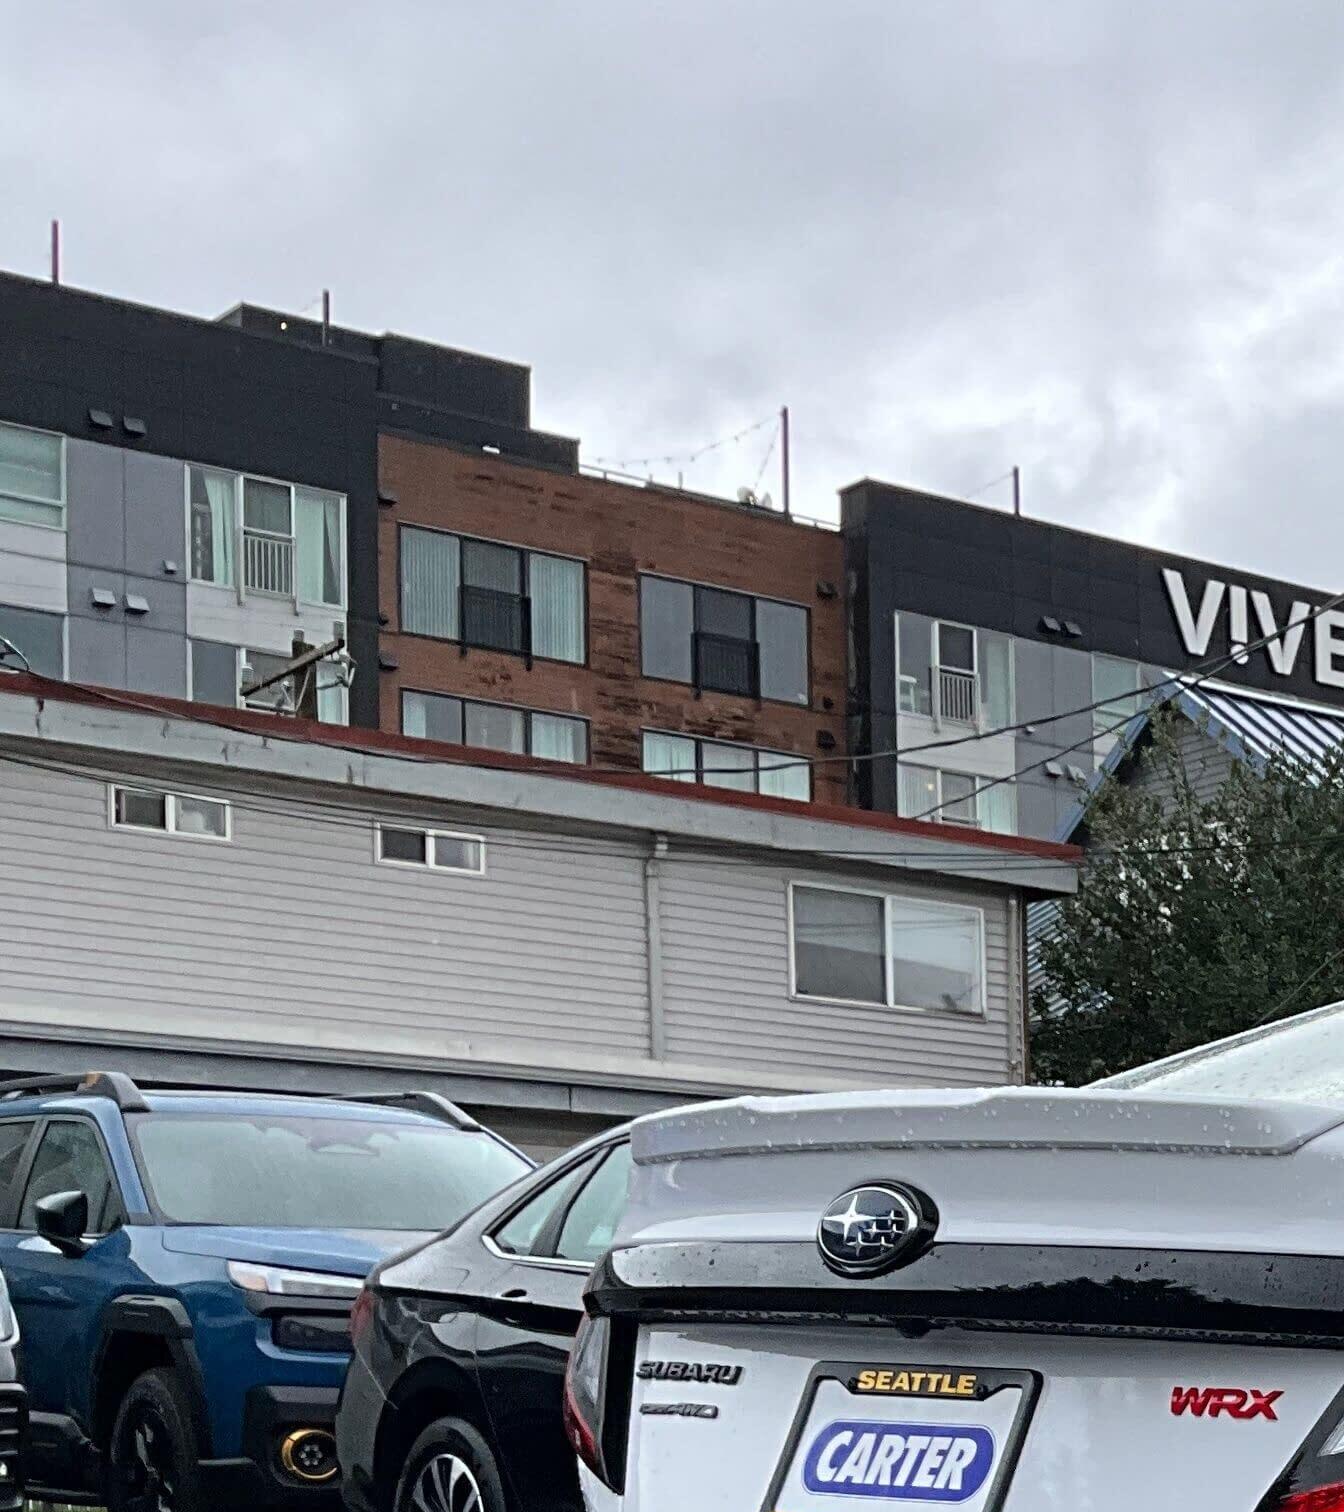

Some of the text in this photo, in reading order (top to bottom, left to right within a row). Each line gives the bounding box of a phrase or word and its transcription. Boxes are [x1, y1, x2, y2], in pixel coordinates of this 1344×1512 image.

[637, 1361, 744, 1386] SUBARU
[857, 1370, 978, 1396] SEATTLE
[1170, 1386, 1285, 1422] WRX
[816, 1430, 978, 1493] CARTER
